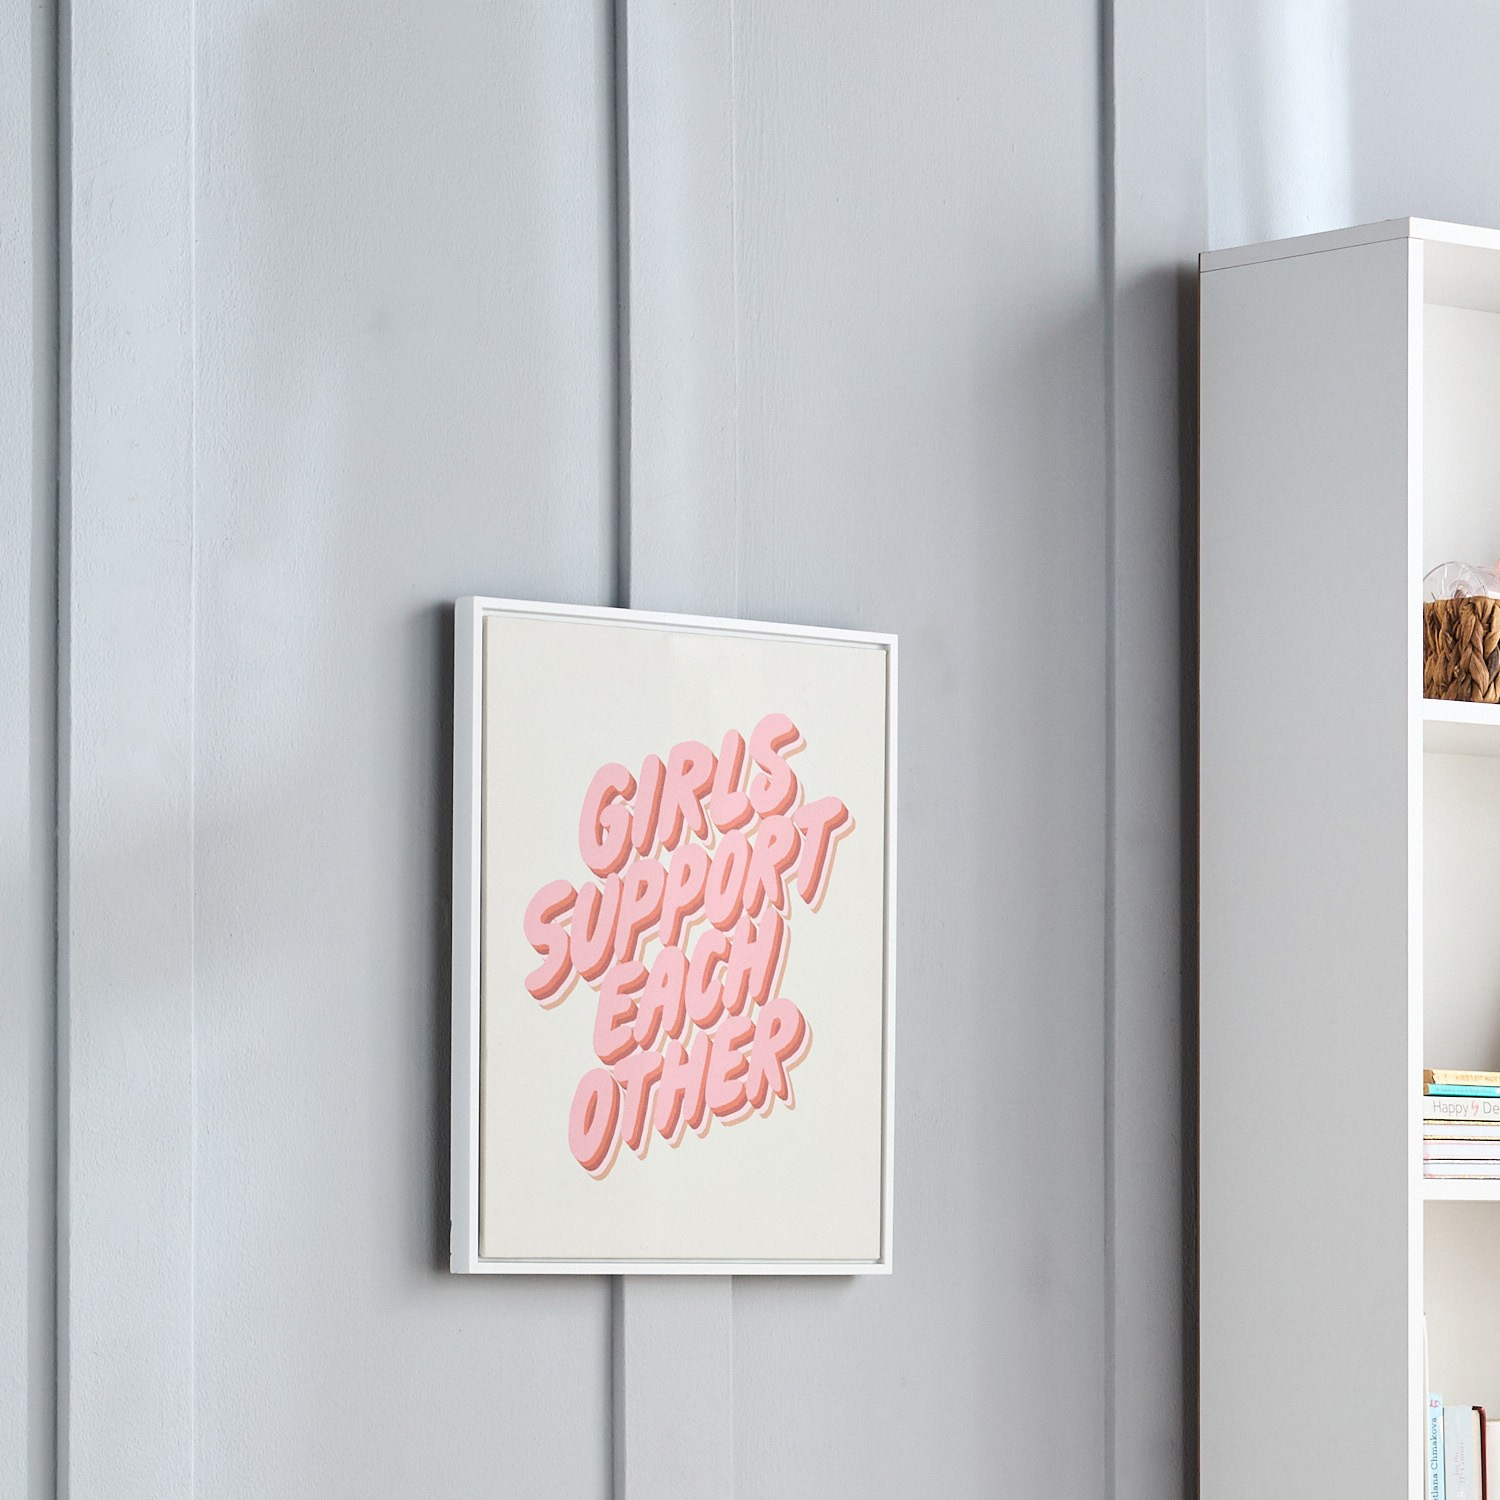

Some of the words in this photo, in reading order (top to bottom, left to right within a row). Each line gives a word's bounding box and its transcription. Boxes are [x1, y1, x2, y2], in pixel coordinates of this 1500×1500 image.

[578, 712, 806, 880] GIRLS
[524, 796, 856, 1010] SUPPORT
[593, 909, 792, 1067] EACH
[568, 998, 814, 1181] OTHER
[1433, 1100, 1469, 1117] Happy
[1430, 1417, 1439, 1471] Chmakova
